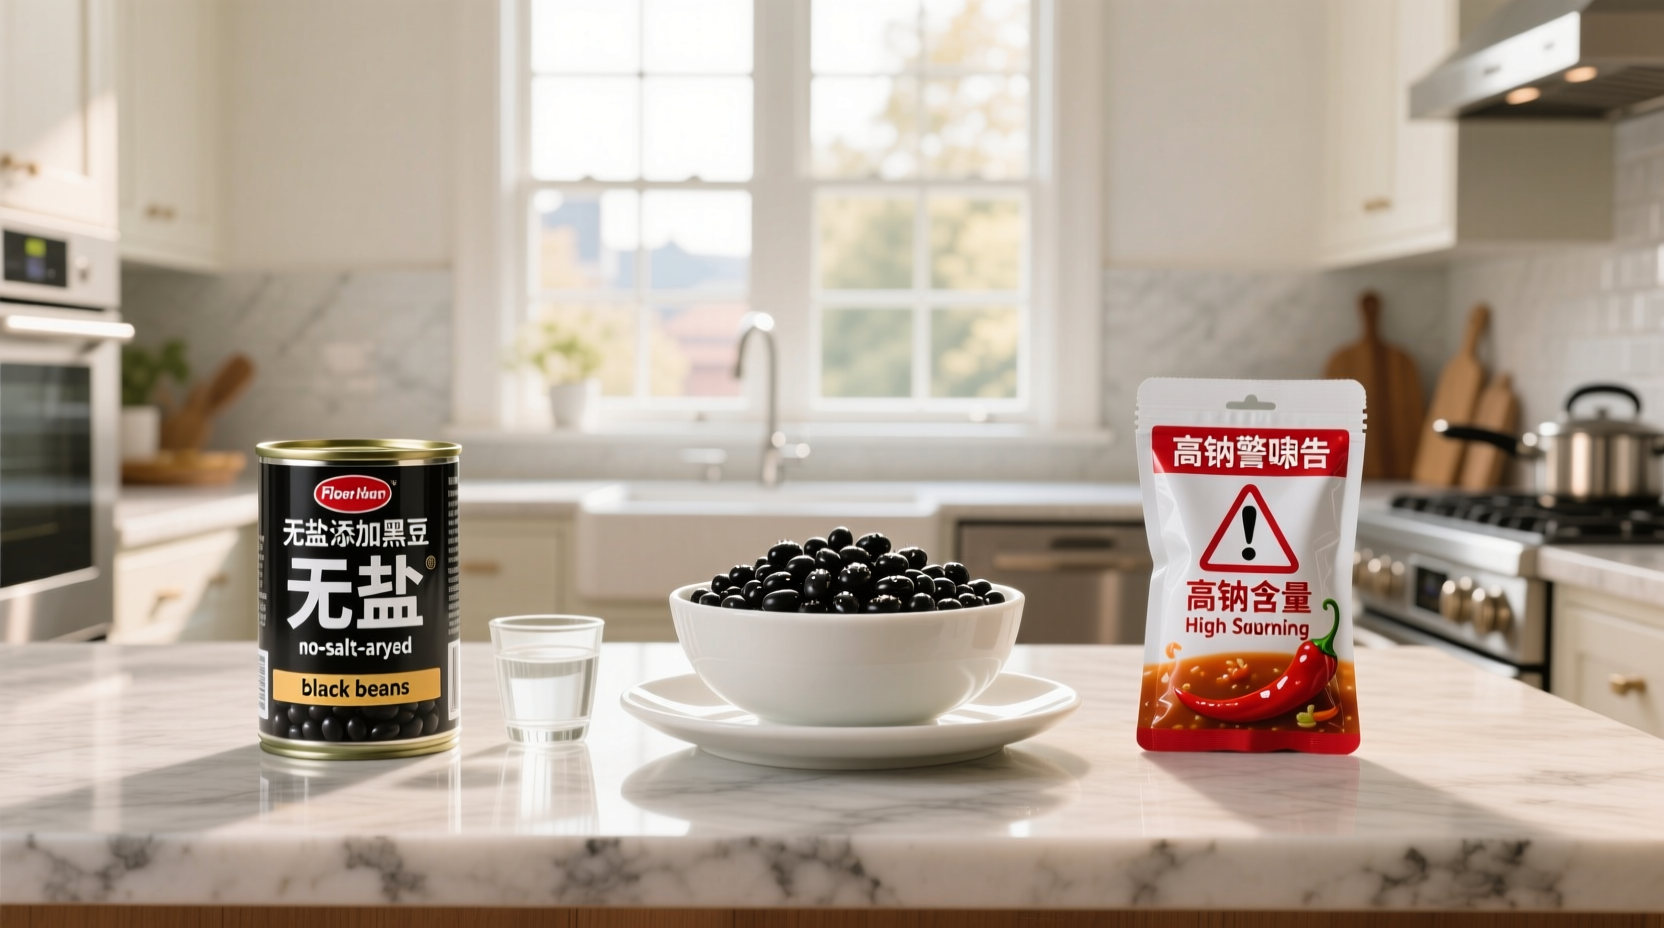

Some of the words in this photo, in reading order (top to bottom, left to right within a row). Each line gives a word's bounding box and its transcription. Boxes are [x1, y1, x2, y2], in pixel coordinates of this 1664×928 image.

[283, 518, 429, 548] 无盐添加黑豆
[287, 554, 424, 630] 无盐
[1186, 579, 1312, 613] 高钠含量
[1185, 617, 1227, 638] High
[299, 635, 413, 660] no-salt-aryed
[302, 678, 350, 698] black
[355, 679, 410, 698] beans
